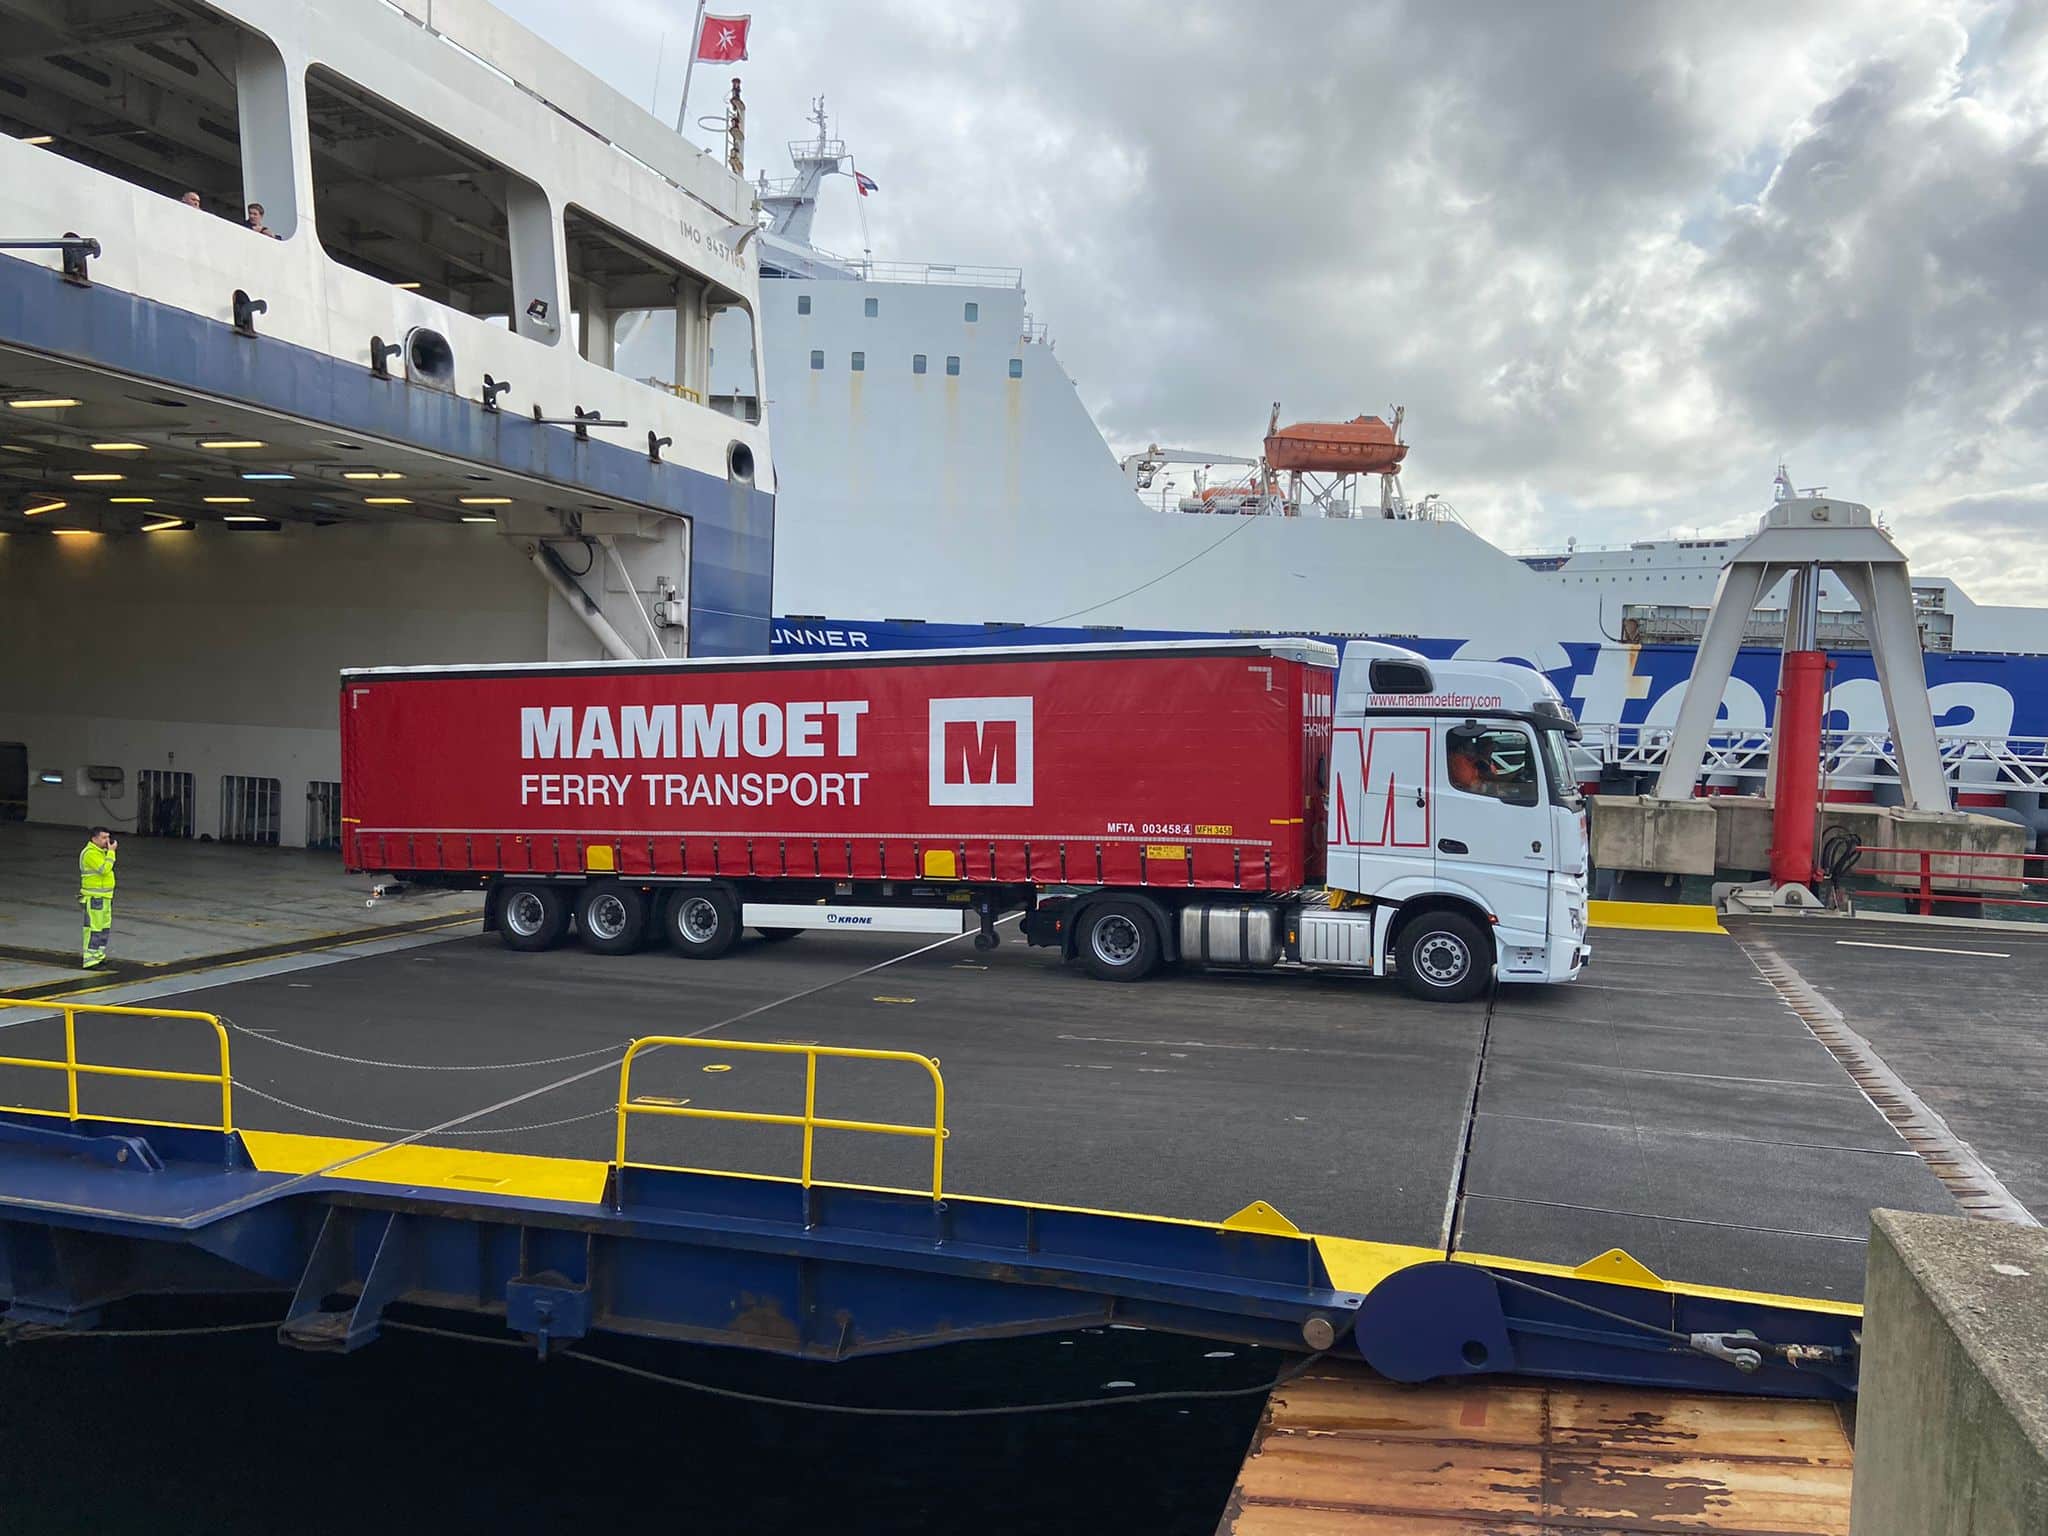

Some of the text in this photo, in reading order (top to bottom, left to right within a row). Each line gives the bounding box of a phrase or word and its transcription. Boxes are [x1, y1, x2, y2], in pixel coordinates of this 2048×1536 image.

[680, 219, 701, 244] IMO
[1369, 692, 1501, 711] www.mammoetferry.com
[521, 700, 869, 758] MAMMOET
[521, 772, 869, 806] FERRY TRANSPORT
[1107, 822, 1135, 833] MFTA
[838, 916, 872, 924] KRONE
